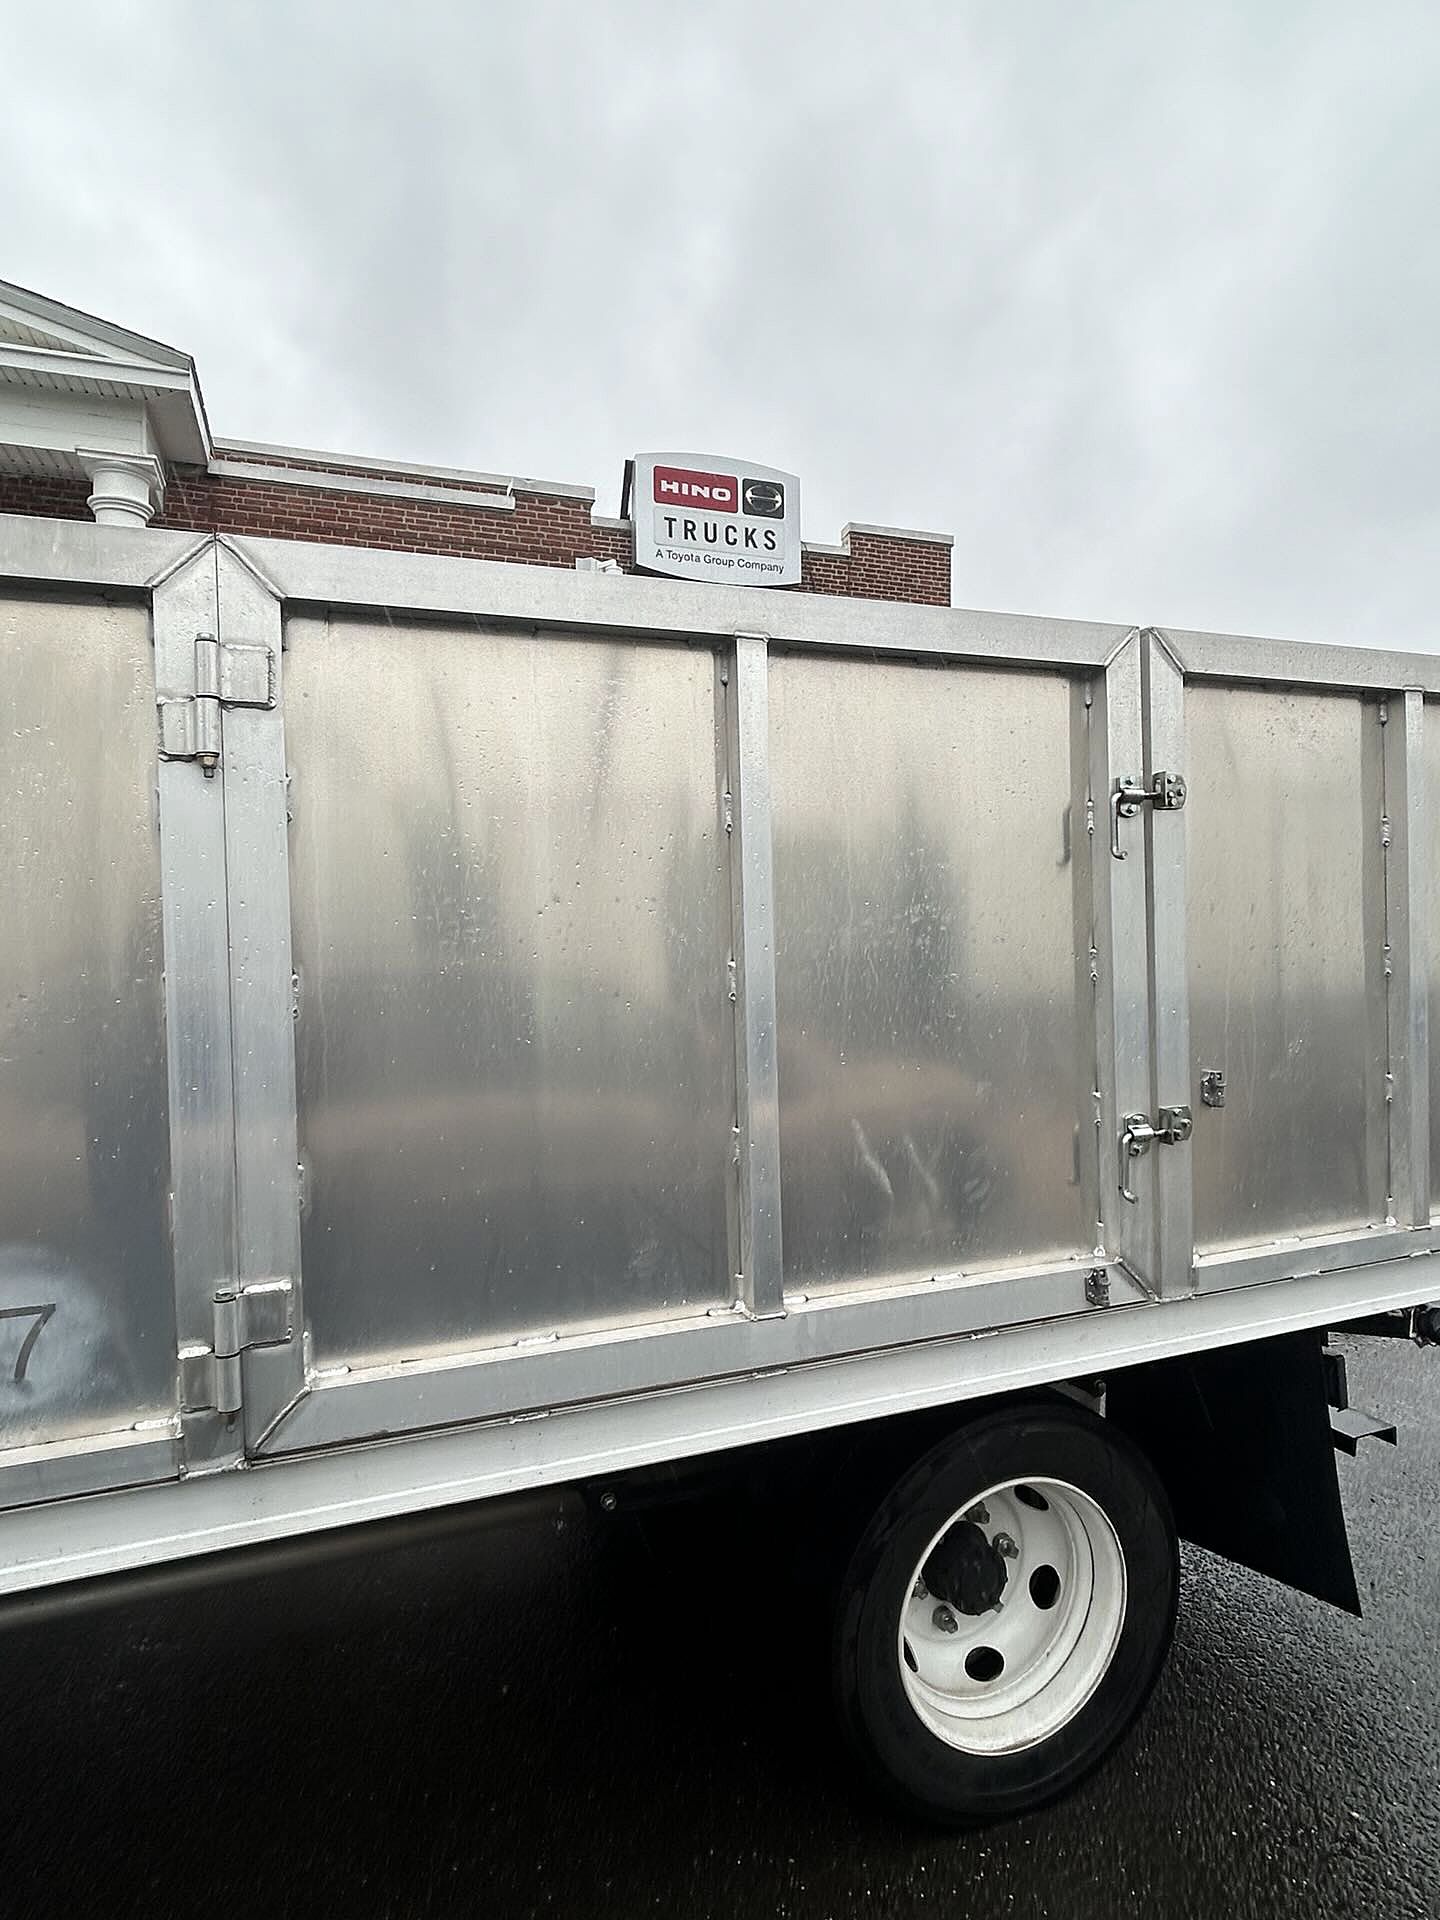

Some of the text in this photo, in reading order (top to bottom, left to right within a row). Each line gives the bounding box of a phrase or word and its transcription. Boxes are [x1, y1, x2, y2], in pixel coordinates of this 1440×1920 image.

[660, 480, 732, 502] HINO
[663, 516, 776, 551] TRUCKS
[655, 549, 784, 574] A Toyota Group Company
